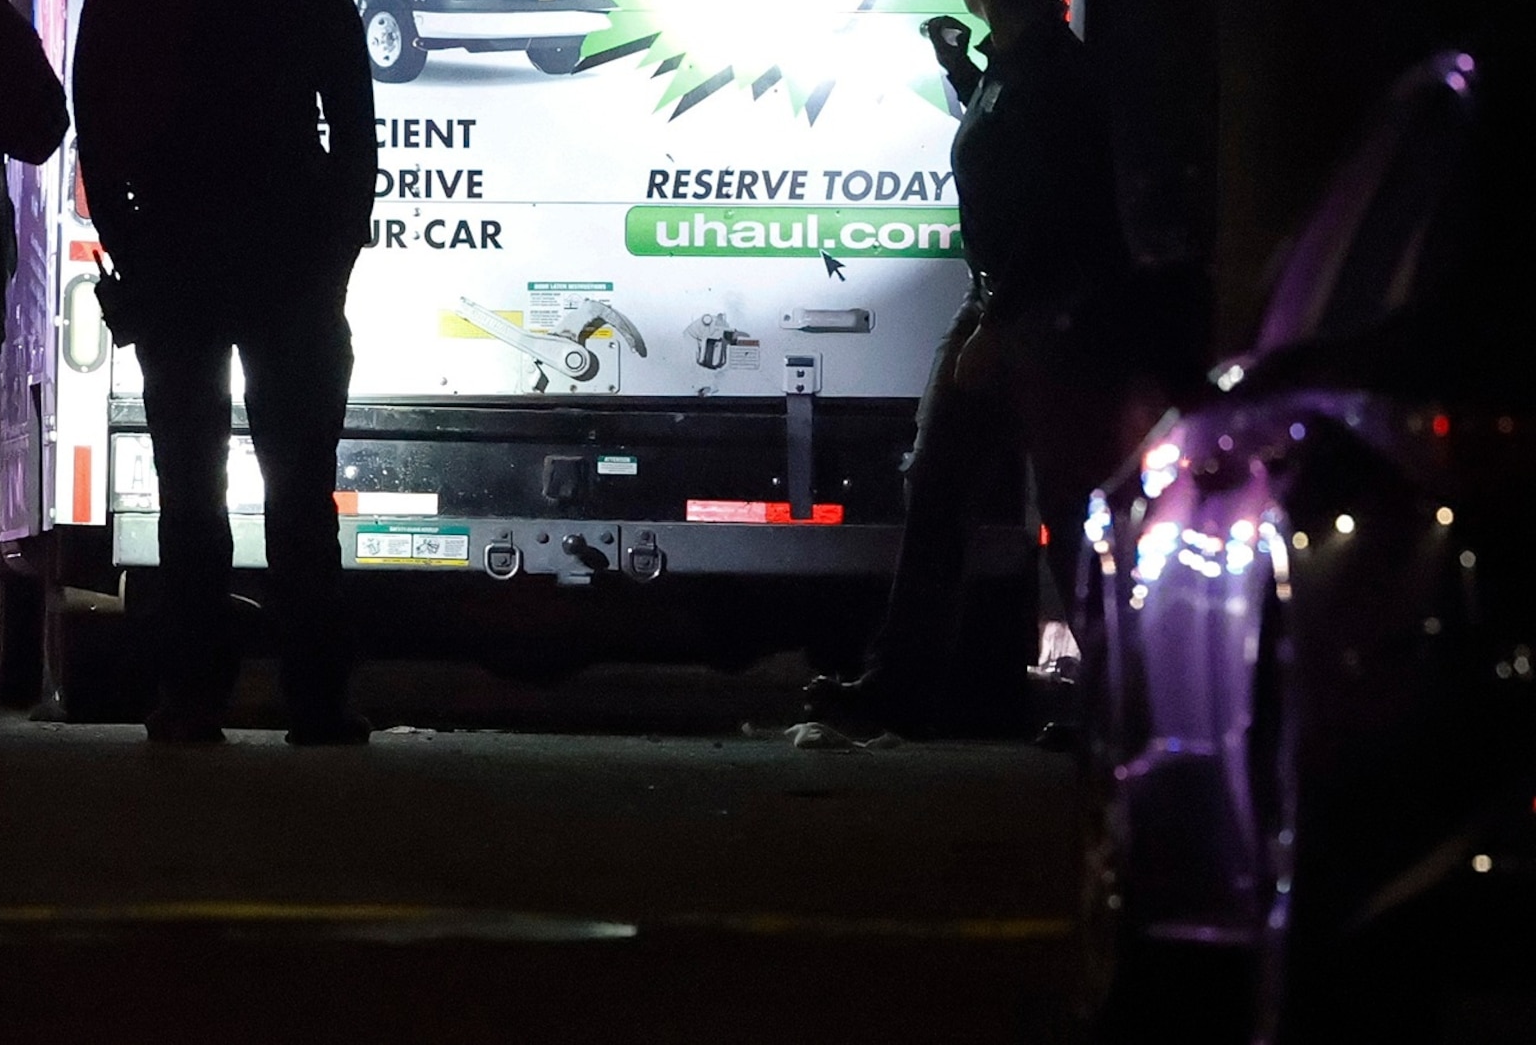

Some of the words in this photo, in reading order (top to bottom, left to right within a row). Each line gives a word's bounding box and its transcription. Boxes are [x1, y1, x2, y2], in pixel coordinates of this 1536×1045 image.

[373, 168, 483, 199] DRIVE
[646, 169, 809, 200] RESERVE
[822, 170, 954, 202] TODAY
[424, 219, 504, 250] CAR
[654, 212, 964, 250] uhaul.com
